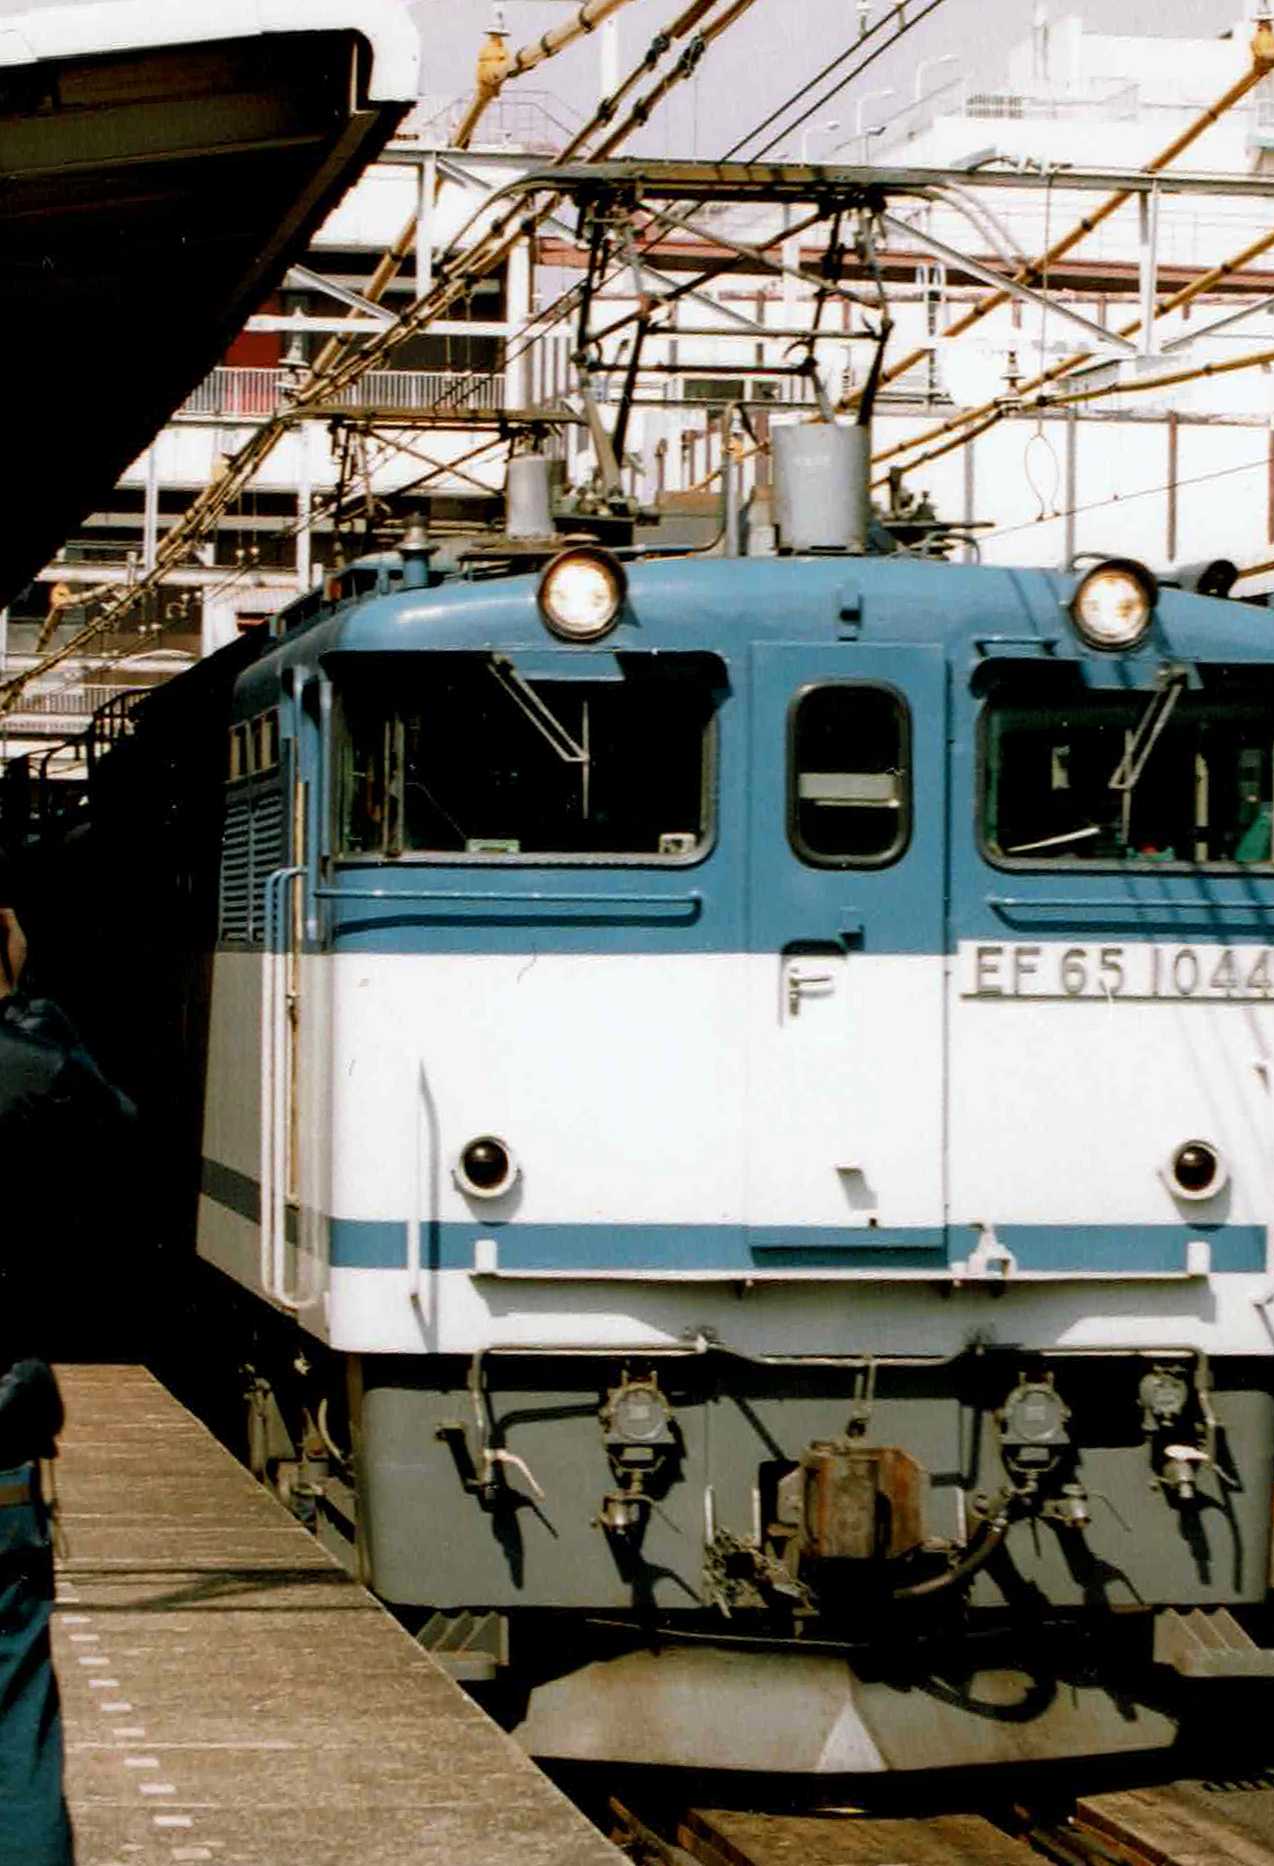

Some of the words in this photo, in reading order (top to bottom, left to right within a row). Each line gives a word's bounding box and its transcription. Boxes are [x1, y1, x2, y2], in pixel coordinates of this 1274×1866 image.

[976, 946, 1041, 997] EF
[1060, 946, 1124, 996] 65
[1151, 947, 1273, 999] 1044
